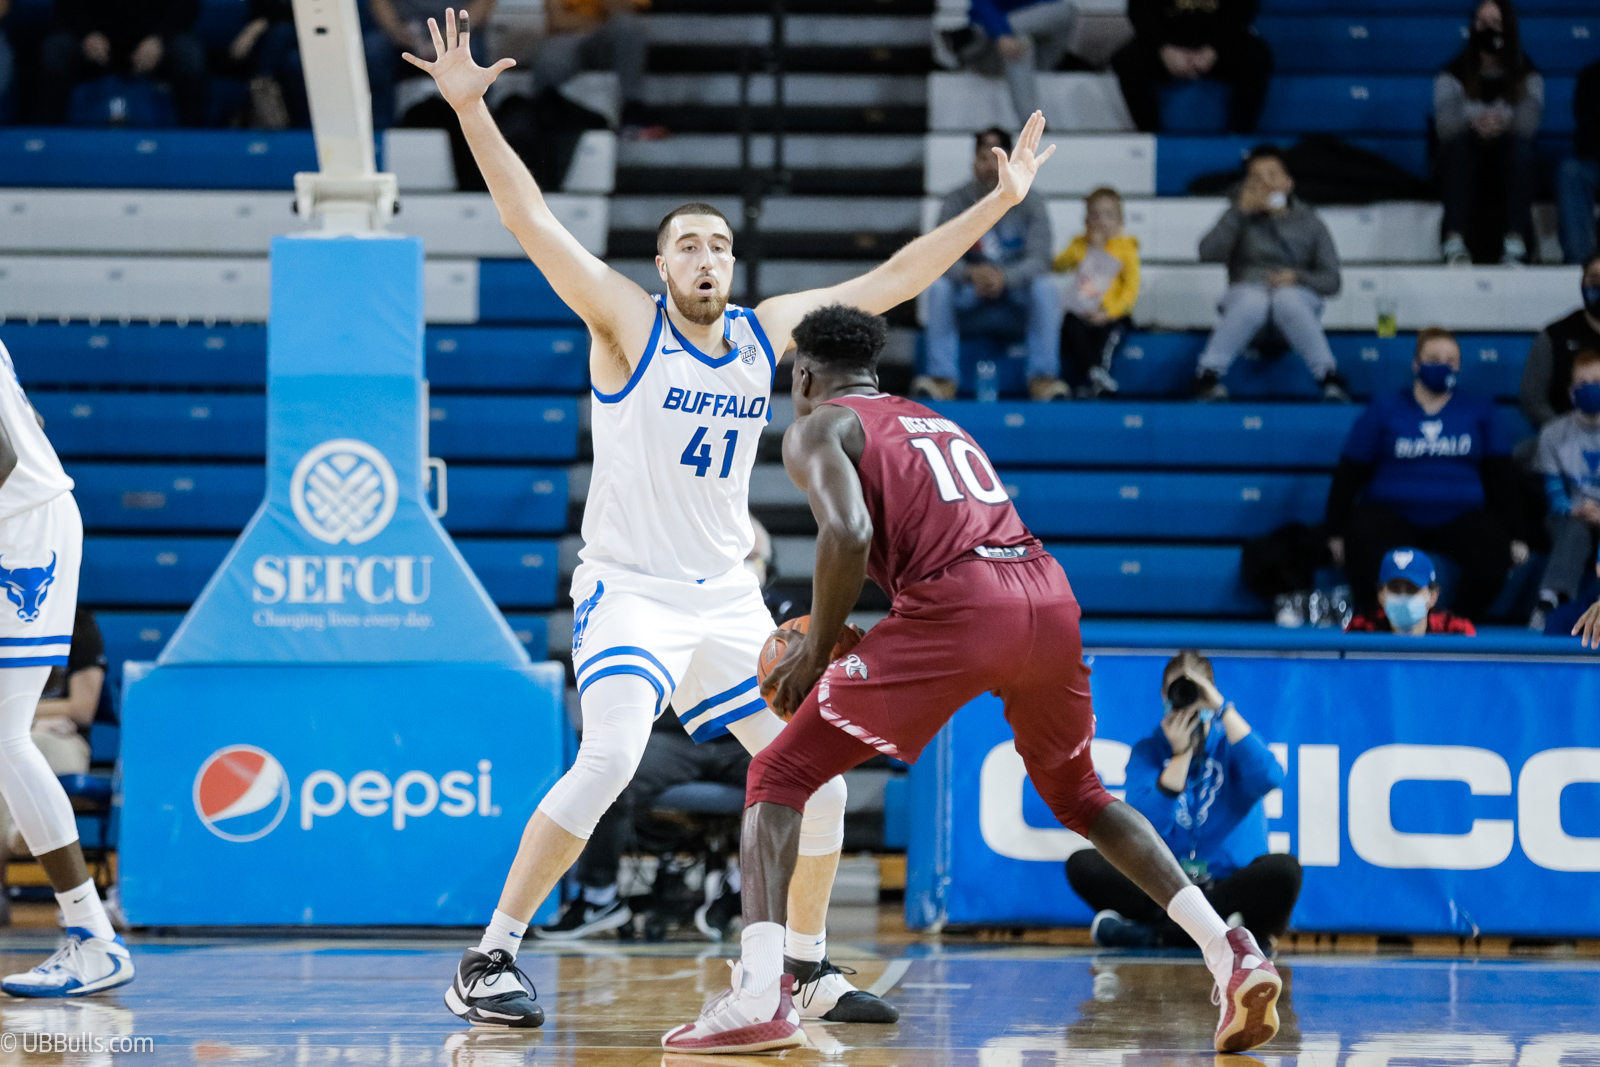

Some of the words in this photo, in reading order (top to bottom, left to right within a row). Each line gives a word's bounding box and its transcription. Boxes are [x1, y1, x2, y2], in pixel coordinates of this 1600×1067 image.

[662, 386, 767, 419] BUFFALO
[680, 426, 739, 478] 41
[907, 435, 1011, 507] 10
[252, 554, 434, 604] SEFCU
[252, 608, 326, 632] Changing
[328, 609, 360, 627] lives
[363, 613, 401, 631] every
[300, 759, 492, 830] pepsi
